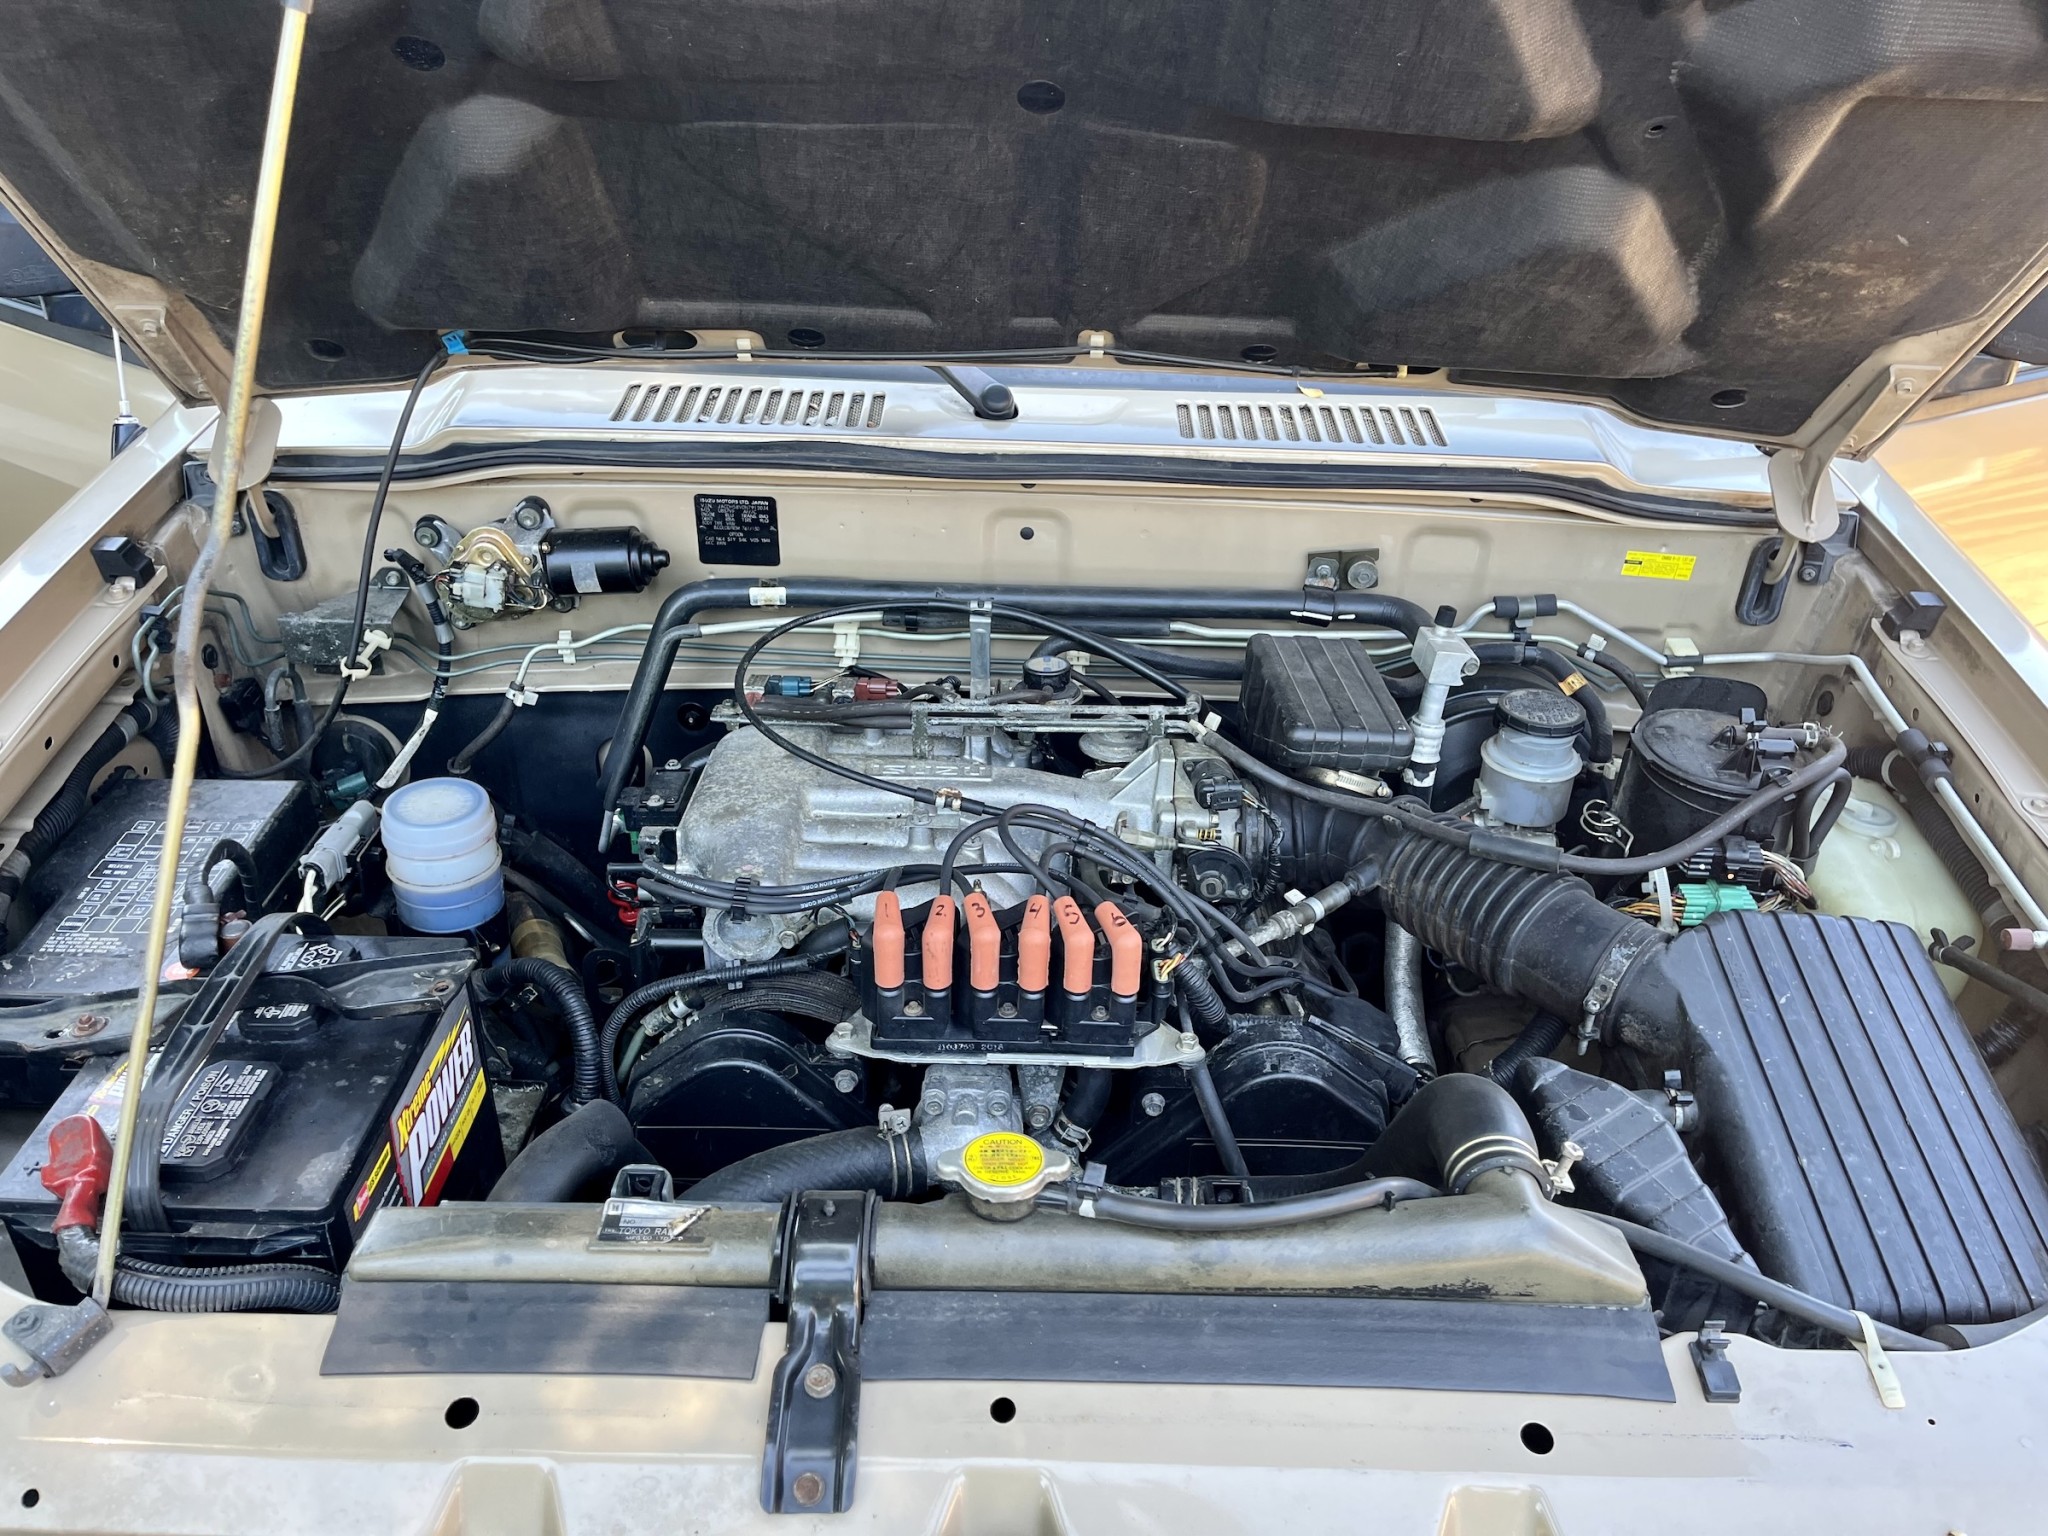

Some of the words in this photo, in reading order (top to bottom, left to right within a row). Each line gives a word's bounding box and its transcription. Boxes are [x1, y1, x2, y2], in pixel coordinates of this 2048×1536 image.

[802, 882, 819, 891] CORE
[971, 902, 986, 919] 3
[1029, 903, 1042, 919] 4
[1064, 905, 1081, 925] 5
[1110, 911, 1127, 928] 6
[162, 1108, 194, 1144] DANGER
[191, 1070, 220, 1101] POISON
[396, 1069, 433, 1154] Xtreme
[407, 1019, 475, 1207] POWER
